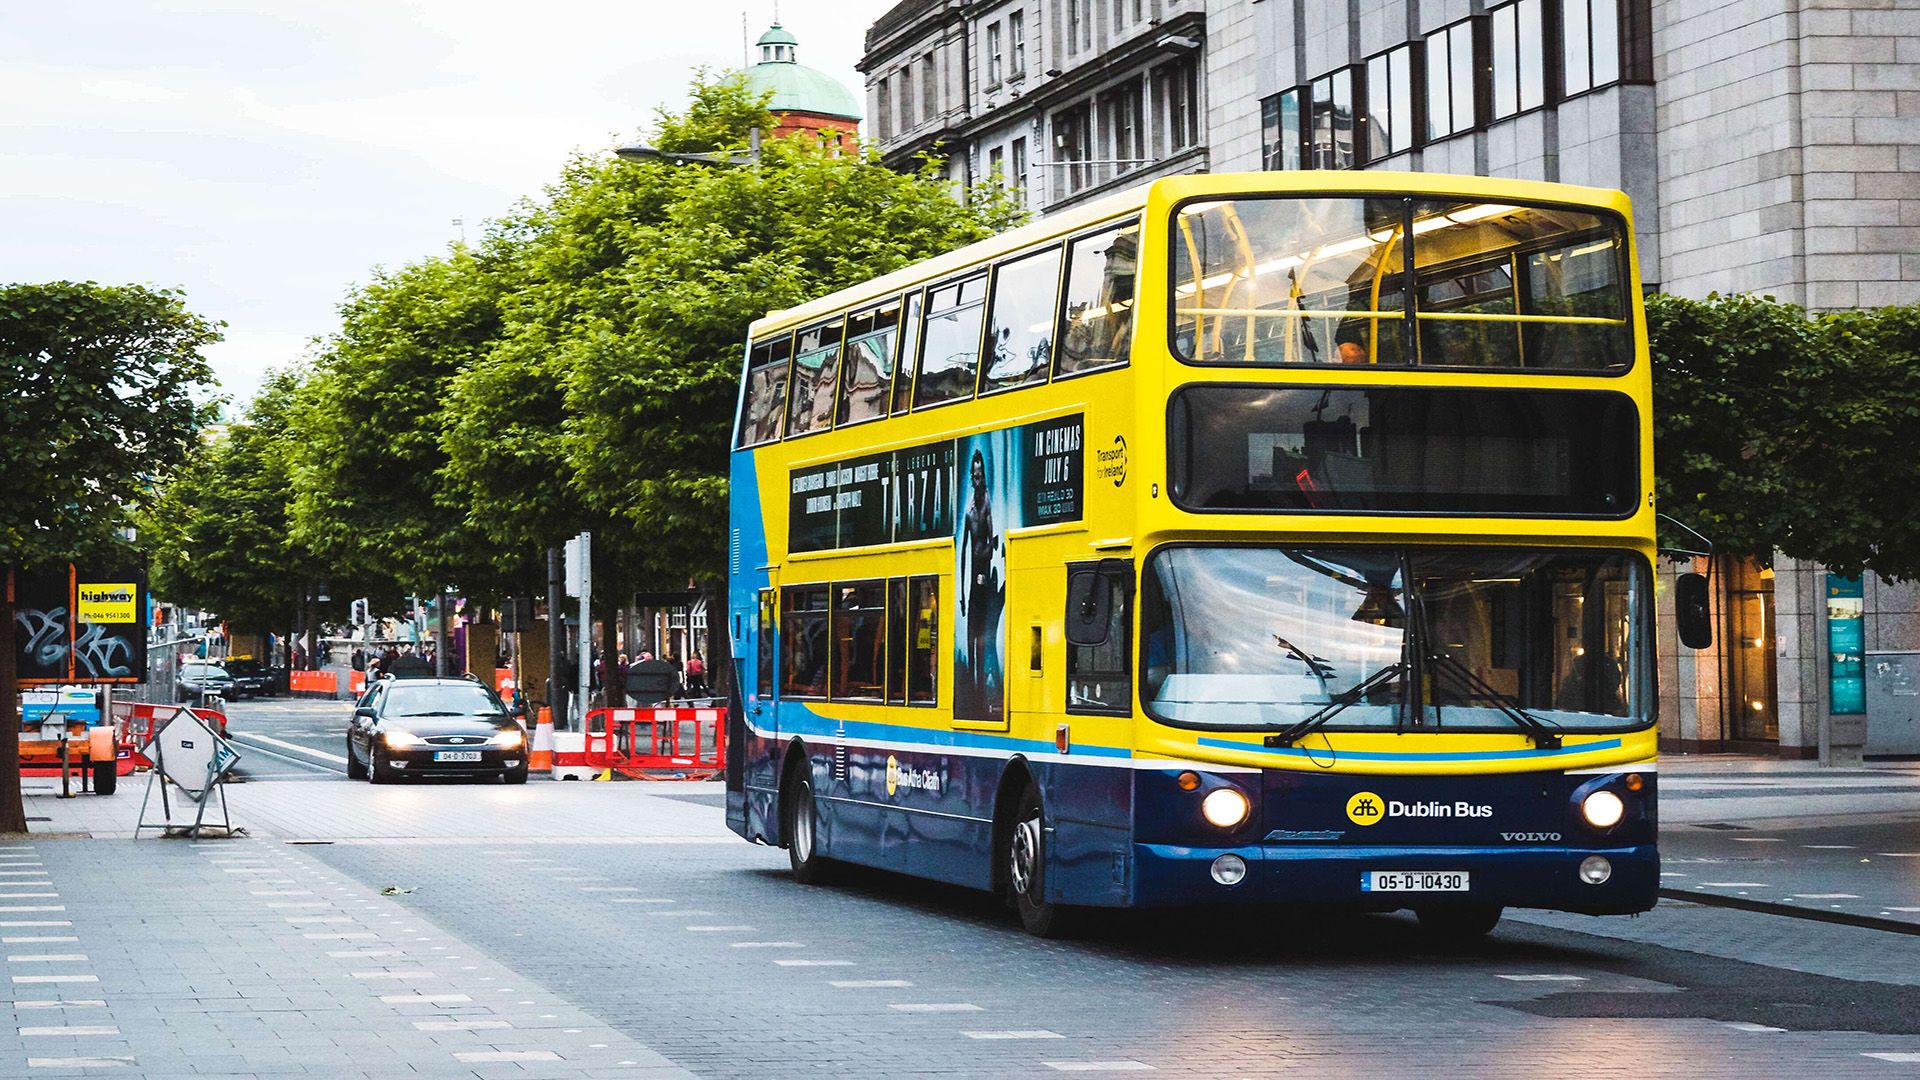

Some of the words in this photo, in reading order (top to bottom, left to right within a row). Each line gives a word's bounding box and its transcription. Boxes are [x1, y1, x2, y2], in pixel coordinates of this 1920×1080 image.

[1035, 432, 1044, 457] IN
[1045, 424, 1081, 455] CINEMAS
[1096, 447, 1123, 463] Transport
[1043, 457, 1062, 484] JULY
[1063, 455, 1070, 482] 6
[1104, 462, 1123, 478] Ireland
[81, 591, 134, 602] highway
[896, 766, 908, 787] Bus
[921, 769, 940, 791] Cliath
[1388, 801, 1451, 817] Dublin
[1454, 801, 1493, 818] Bus
[1500, 832, 1562, 841] VOLVO
[1379, 875, 1462, 889] 05-D-10430
